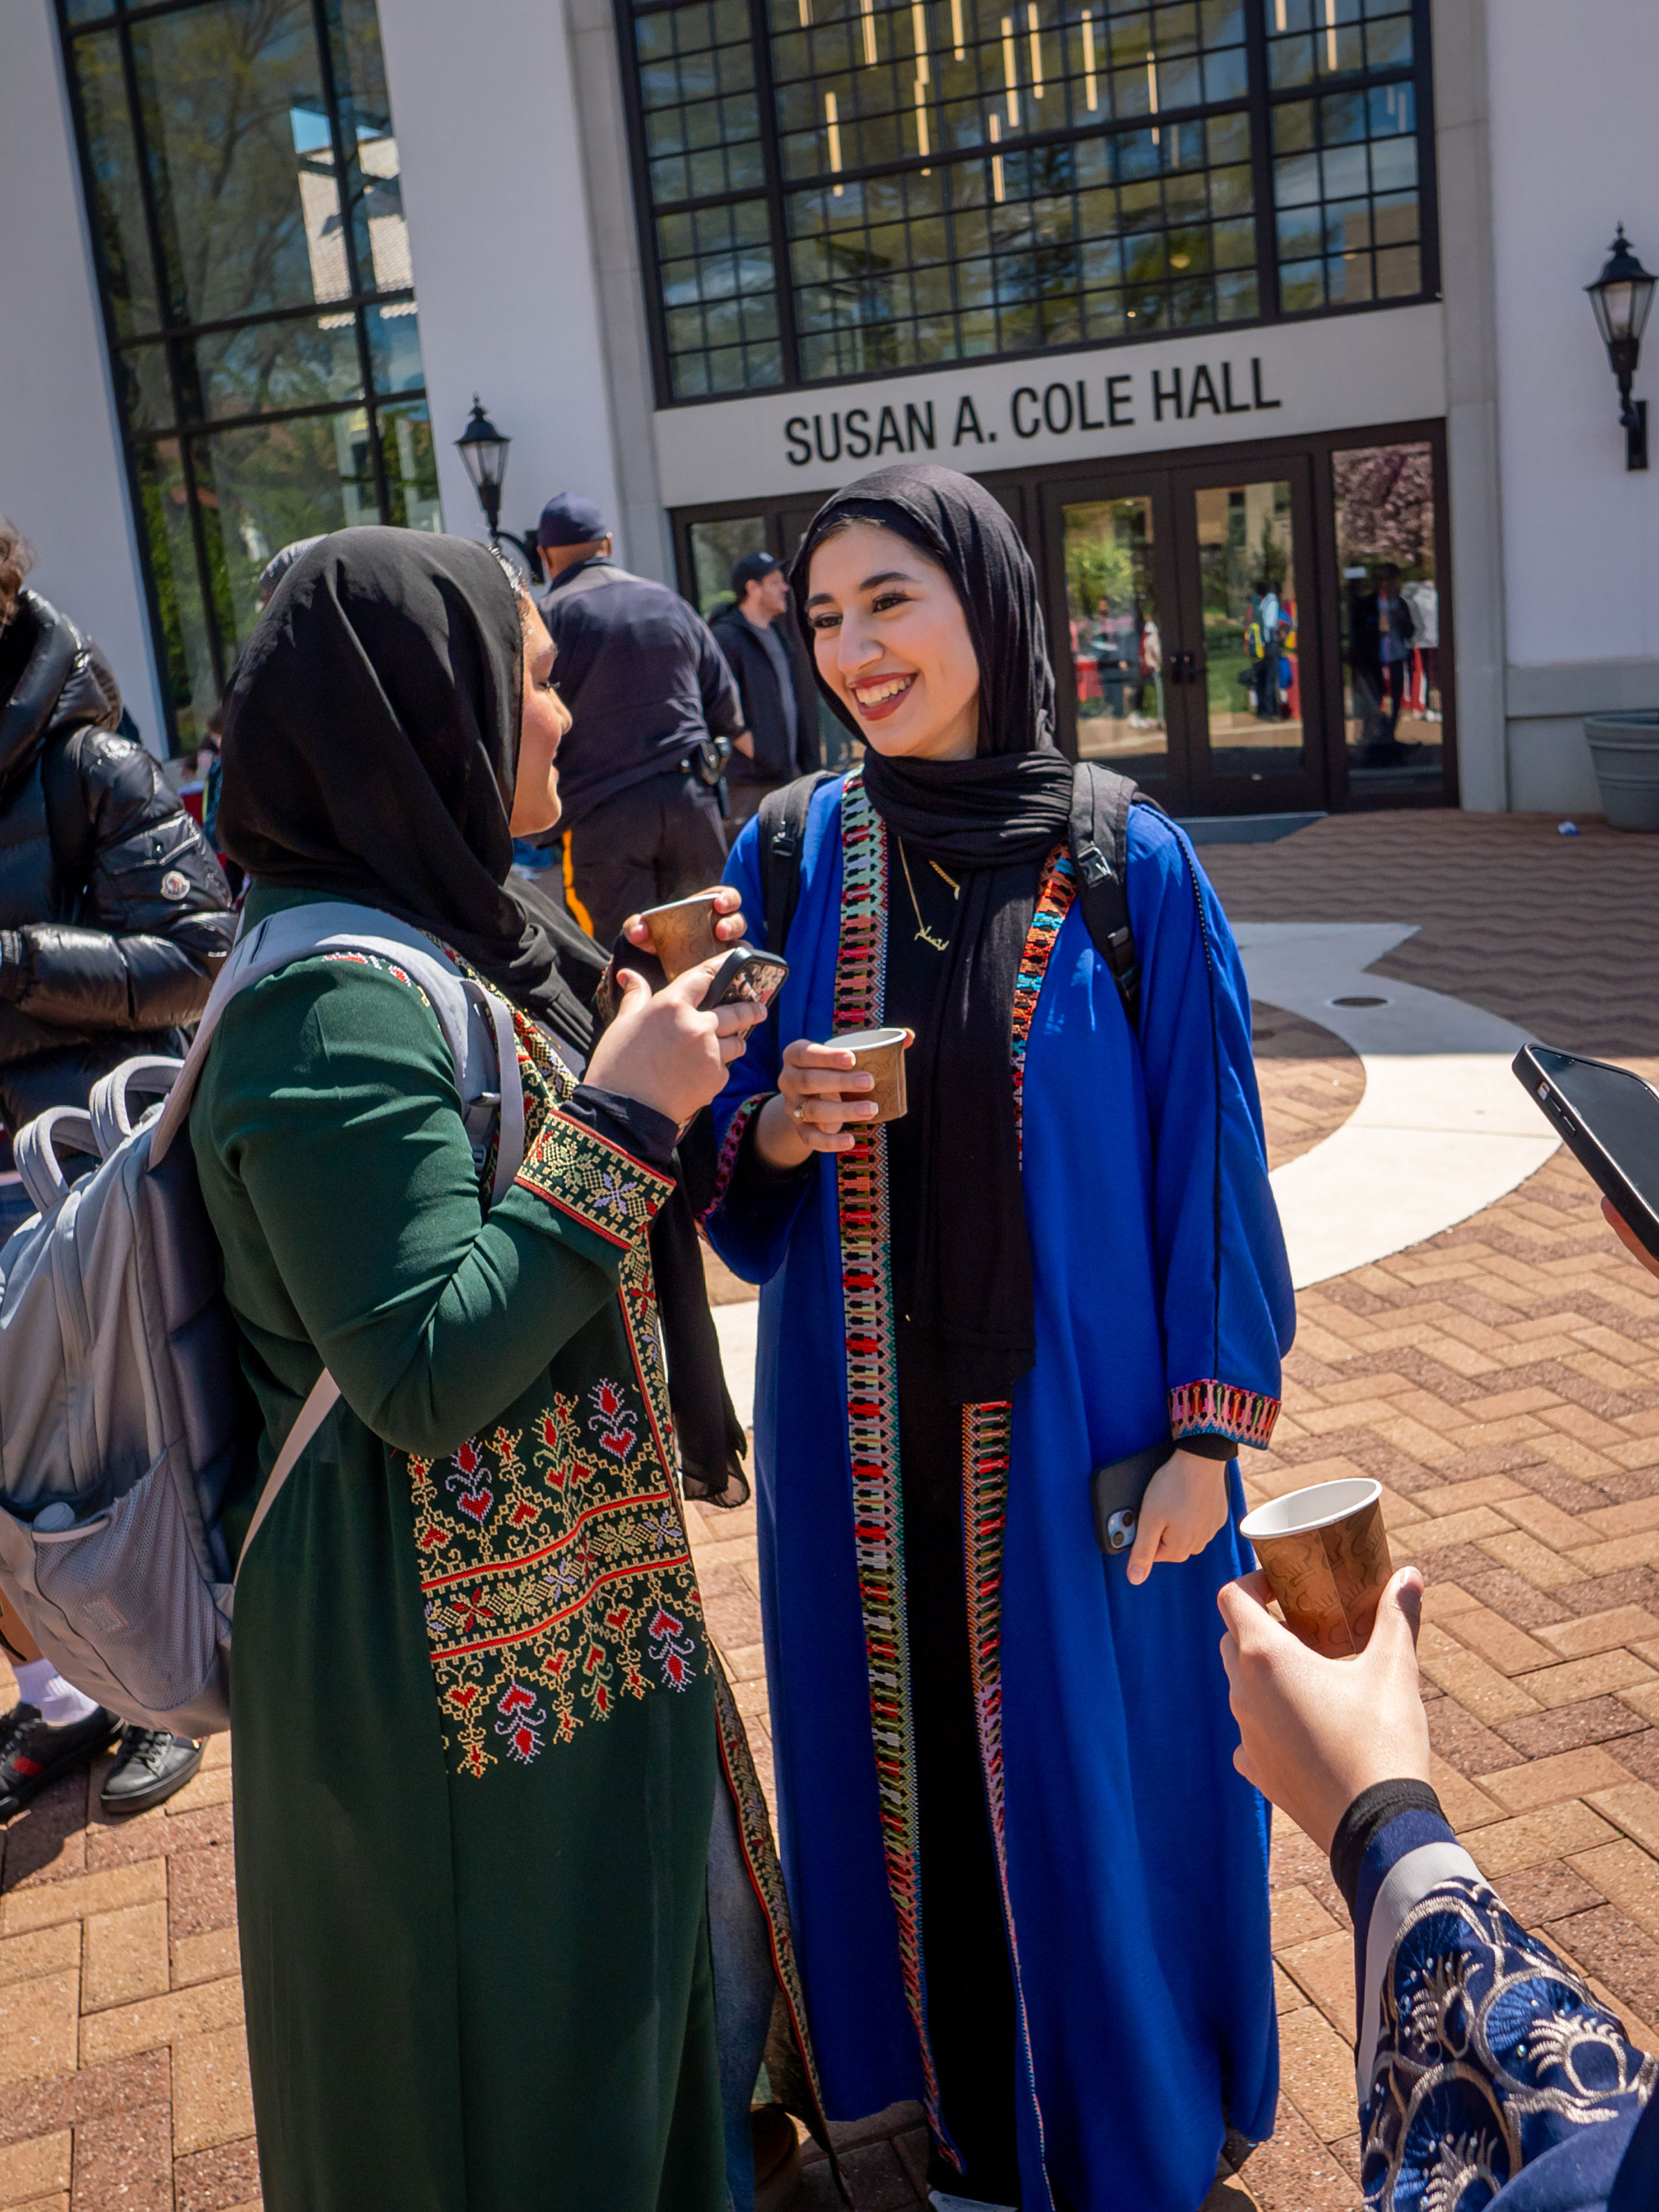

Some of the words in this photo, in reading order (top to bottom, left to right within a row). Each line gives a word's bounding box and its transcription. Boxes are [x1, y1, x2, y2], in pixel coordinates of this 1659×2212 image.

[785, 400, 936, 466] SUSAN
[952, 395, 997, 447] A.
[1011, 374, 1135, 439] COLE
[1152, 356, 1282, 422] HALL
